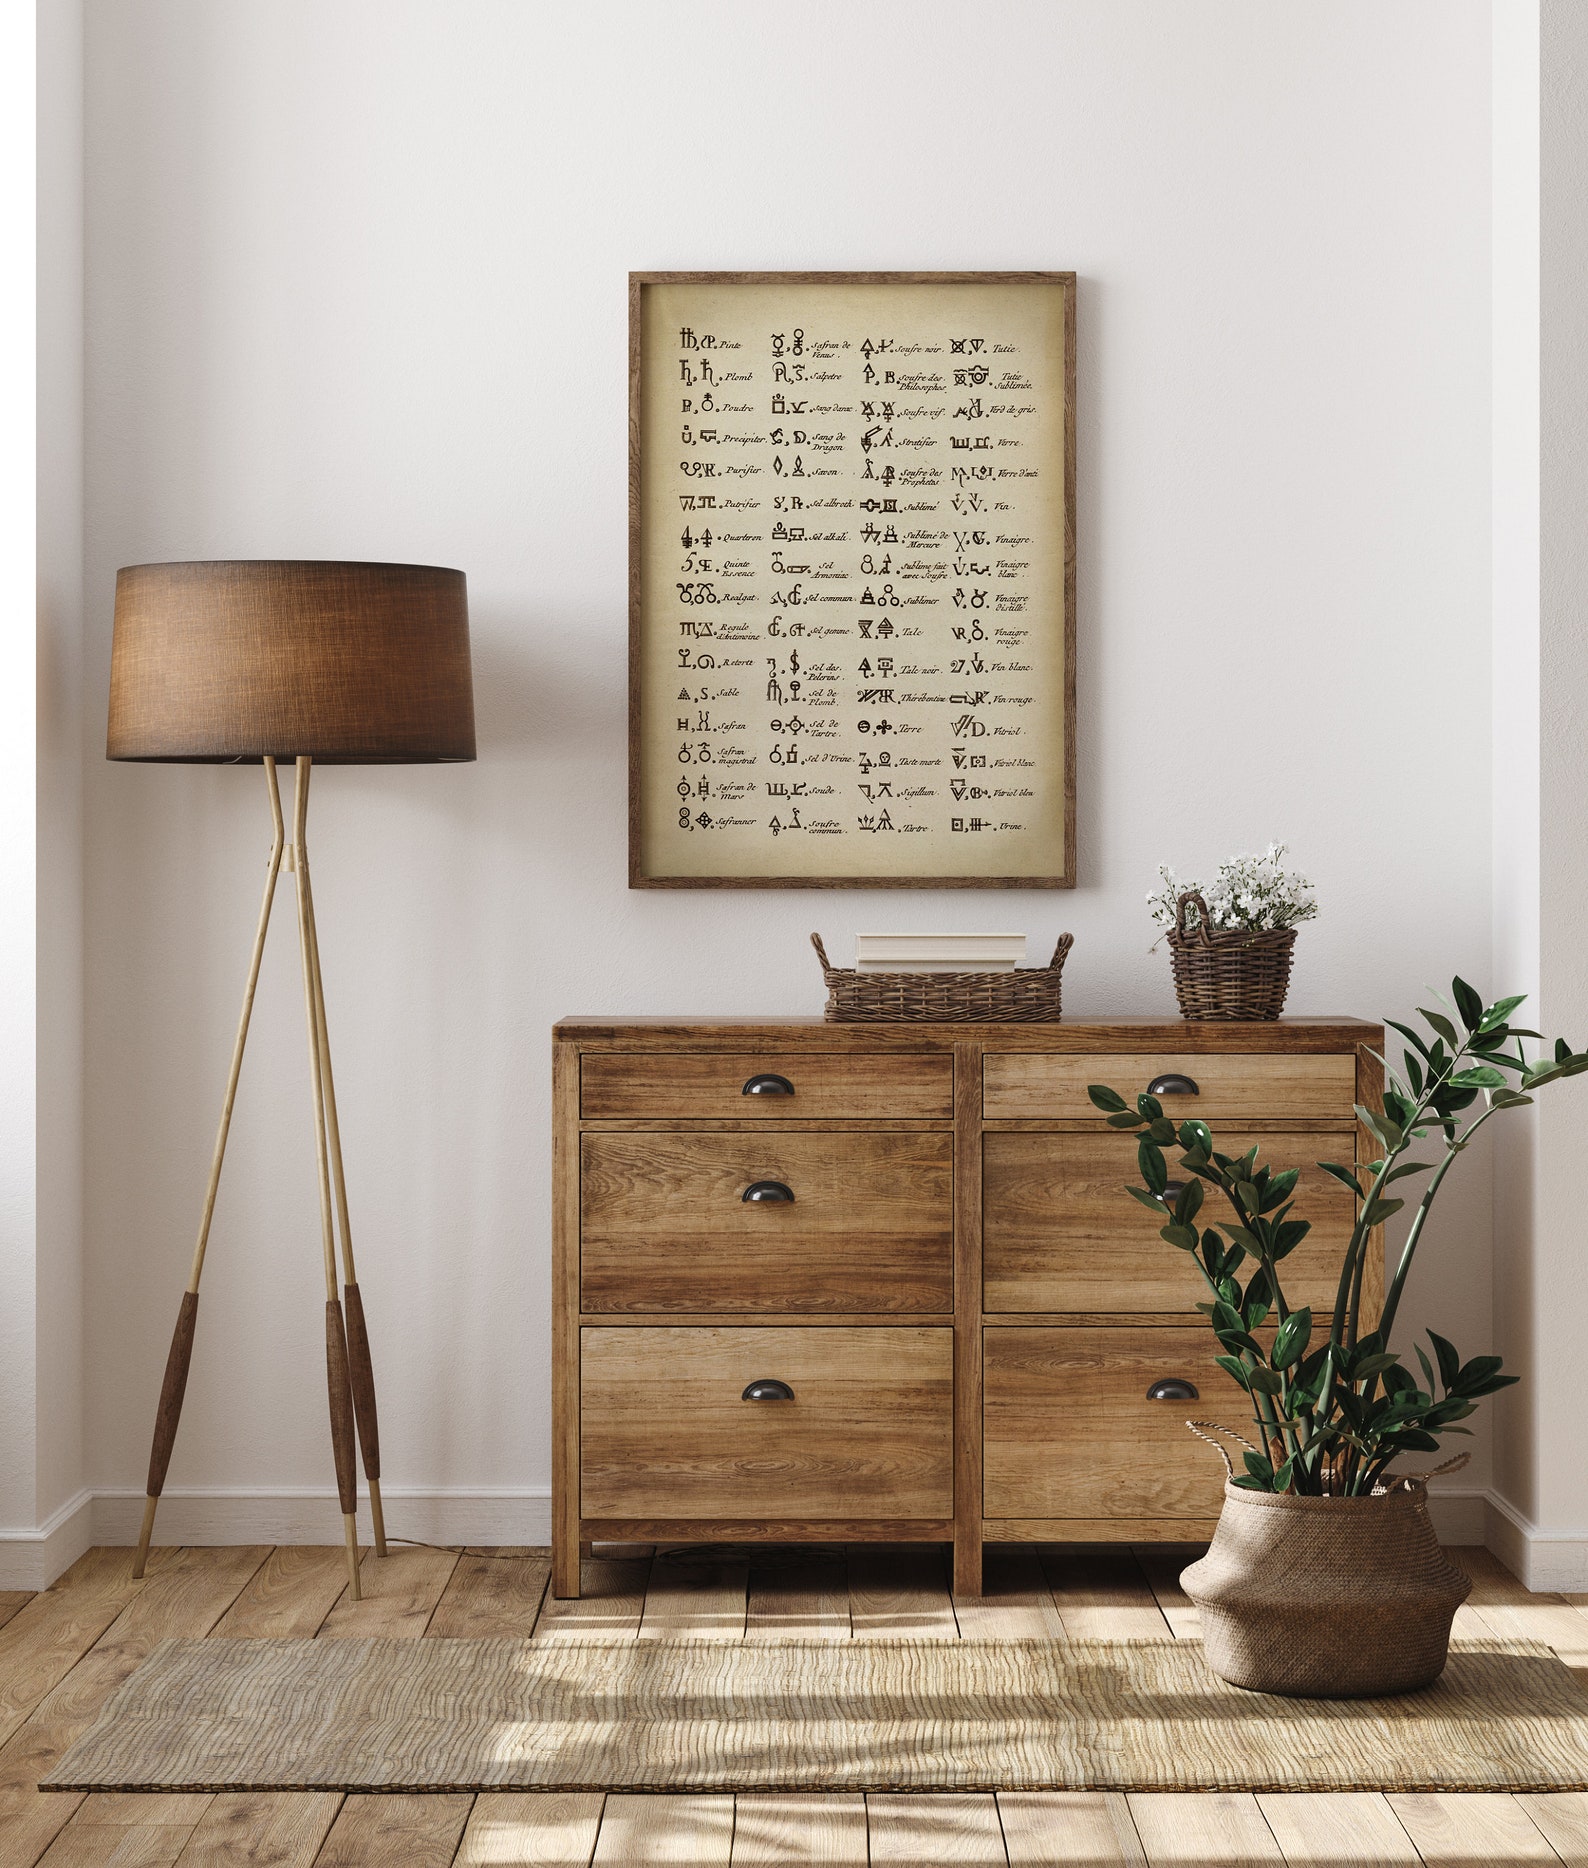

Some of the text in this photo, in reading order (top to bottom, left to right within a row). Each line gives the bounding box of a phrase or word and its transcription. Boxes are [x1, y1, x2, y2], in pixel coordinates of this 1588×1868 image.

[719, 341, 741, 349] Pinte
[842, 341, 851, 349] de
[724, 372, 753, 380] Plomb
[722, 404, 754, 412] Poudre
[1006, 405, 1016, 413] de
[836, 432, 846, 441] de
[811, 444, 844, 454] Dragon
[940, 531, 950, 539] de
[717, 688, 740, 696] Sable
[718, 721, 747, 734] Safran
[717, 747, 745, 758] Safran
[716, 782, 757, 793] Safran de
